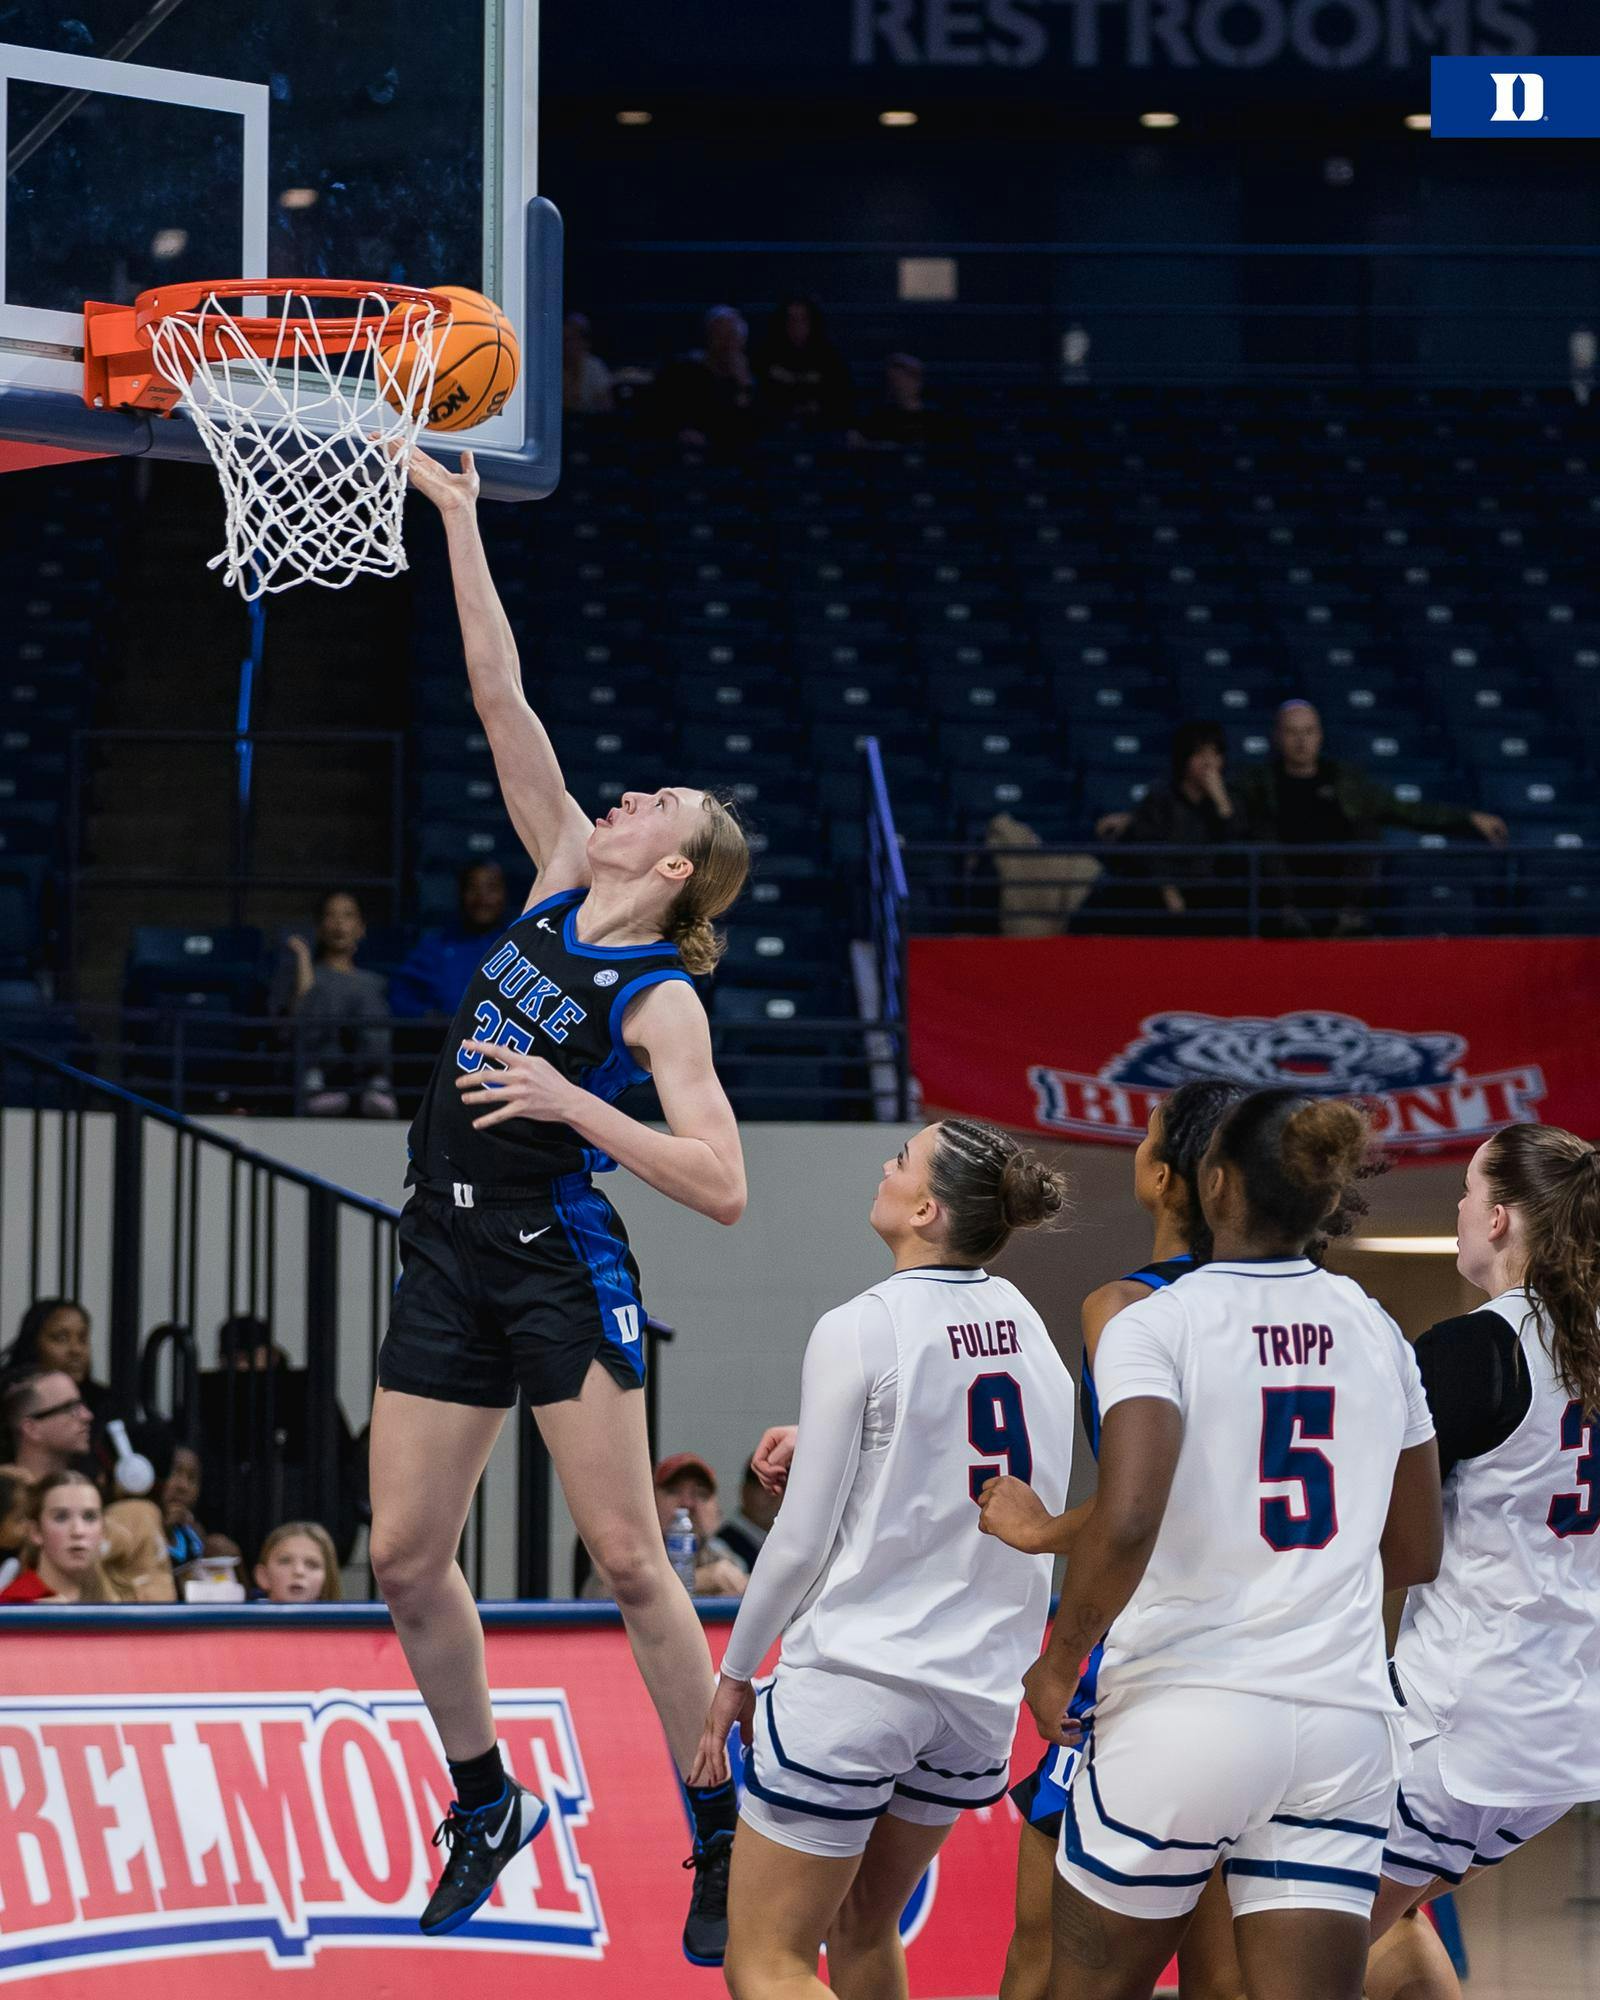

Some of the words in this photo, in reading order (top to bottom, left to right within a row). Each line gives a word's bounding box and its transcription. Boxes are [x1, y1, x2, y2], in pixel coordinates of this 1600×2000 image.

[849, 0, 1535, 66] RESTROOMS
[412, 384, 470, 424] NCA
[482, 940, 587, 1044] DUKE
[612, 1304, 639, 1344] D
[946, 1319, 1023, 1360] FULLER
[1252, 1323, 1334, 1366] TRIPP
[967, 1371, 1033, 1508] 9
[1259, 1385, 1339, 1552] 5
[1546, 1398, 1600, 1539] 3
